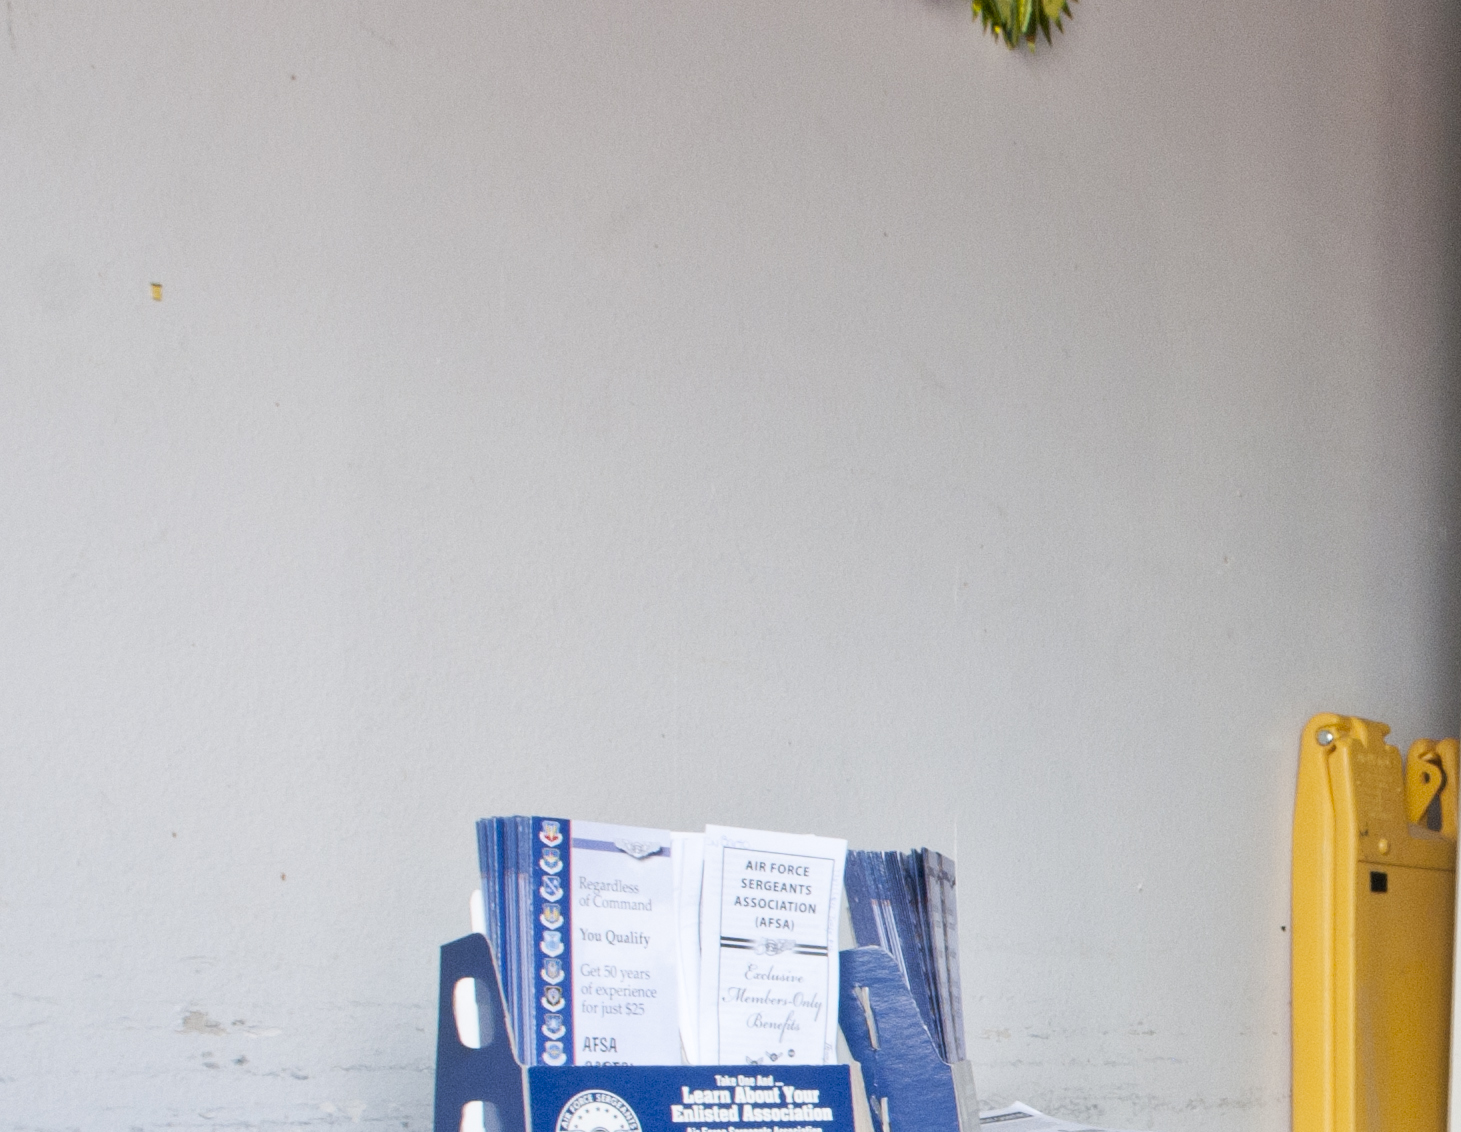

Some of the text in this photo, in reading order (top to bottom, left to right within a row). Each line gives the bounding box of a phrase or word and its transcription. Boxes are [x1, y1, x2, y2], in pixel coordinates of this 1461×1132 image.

[745, 860, 810, 877] AIR FORCE
[578, 876, 639, 894] Regardless
[741, 878, 812, 896] SERGEANTS
[579, 895, 652, 912] of Command
[734, 896, 817, 915] ASSOCIATION
[755, 916, 795, 932] (AFSA)
[580, 928, 651, 948] You Qualify
[580, 964, 651, 984] Get 50 years
[744, 963, 805, 984] Exclusive
[581, 983, 657, 1002] of experience
[581, 1002, 645, 1017] for just $25
[722, 986, 823, 1022] Members-Only
[746, 1010, 801, 1044] Benefits
[582, 1036, 618, 1053] AFSA
[715, 1075, 737, 1087] Take
[738, 1075, 755, 1087] One
[757, 1075, 774, 1087] And
[682, 1086, 820, 1104] Learn About Your
[560, 1094, 638, 1129] AIR FORCE SERGEANTS
[671, 1104, 834, 1122] Enlisted Association
